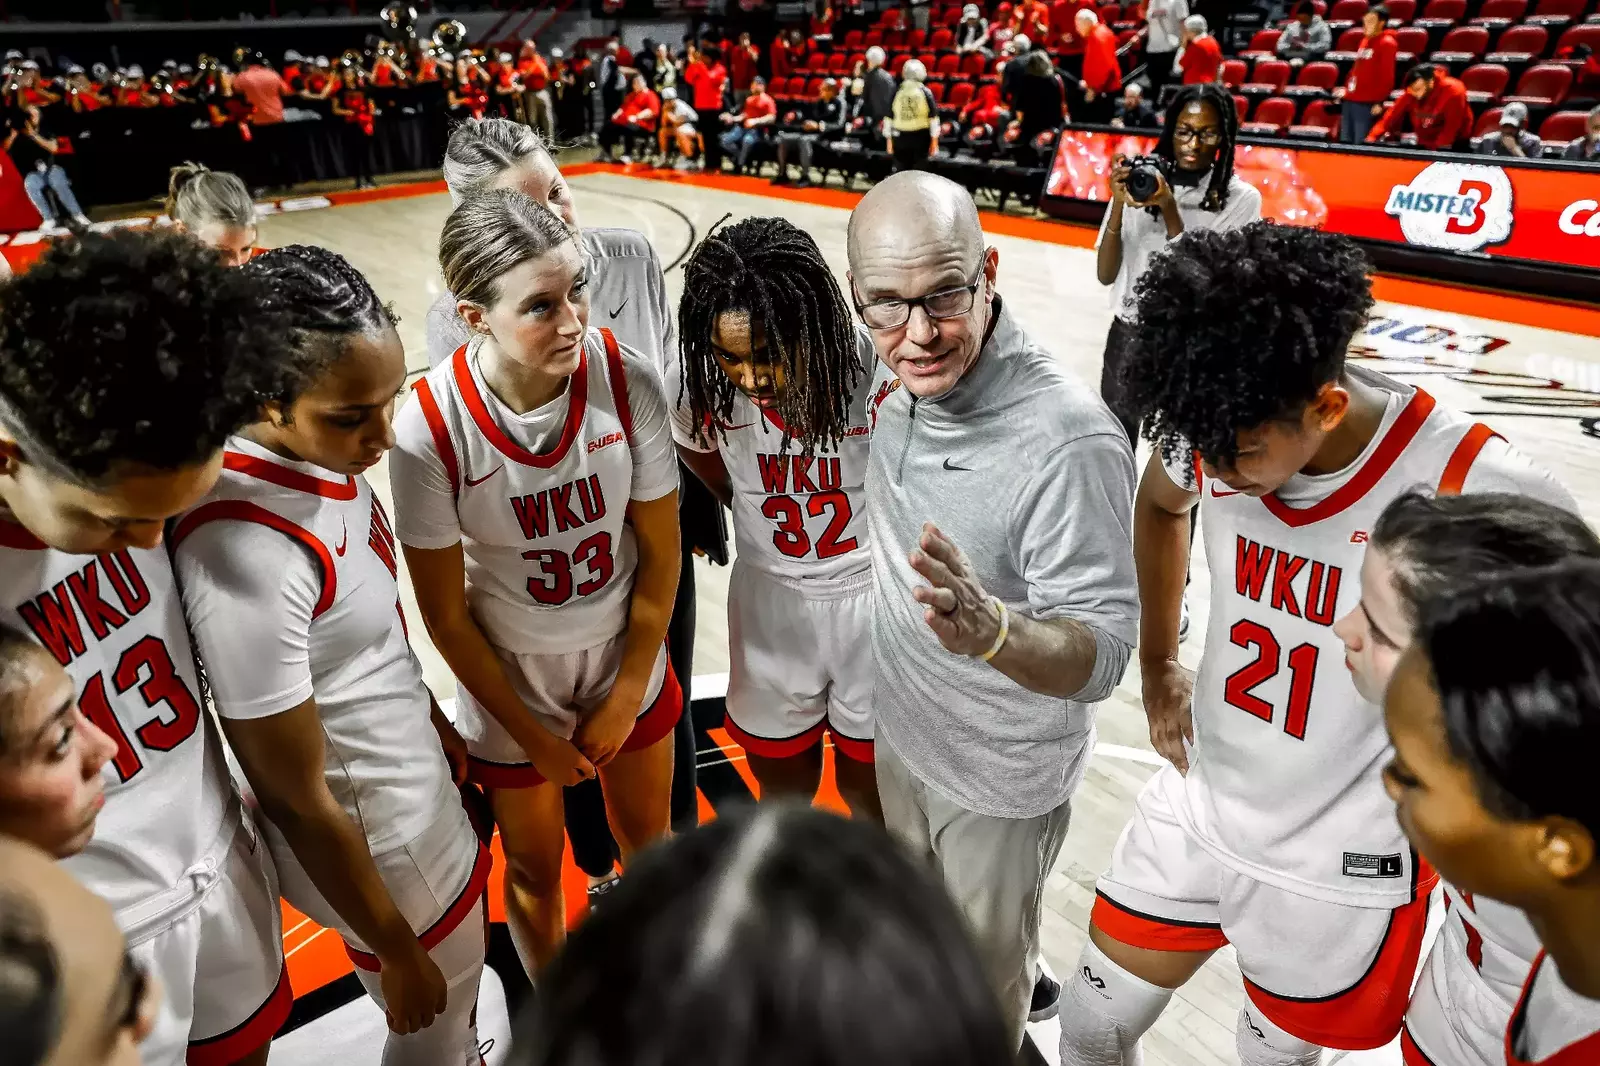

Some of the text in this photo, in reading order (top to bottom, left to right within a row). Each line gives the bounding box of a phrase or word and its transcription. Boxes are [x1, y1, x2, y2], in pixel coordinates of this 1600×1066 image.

[1392, 190, 1475, 217] MISTER
[509, 473, 607, 541] WKU
[757, 453, 843, 494] WKU
[760, 489, 859, 560] 32
[520, 531, 615, 606] 33
[1235, 533, 1343, 627] WKU
[16, 548, 152, 667] WKU
[77, 634, 201, 784] 13
[1223, 618, 1320, 742] 21
[1387, 861, 1395, 872] L
